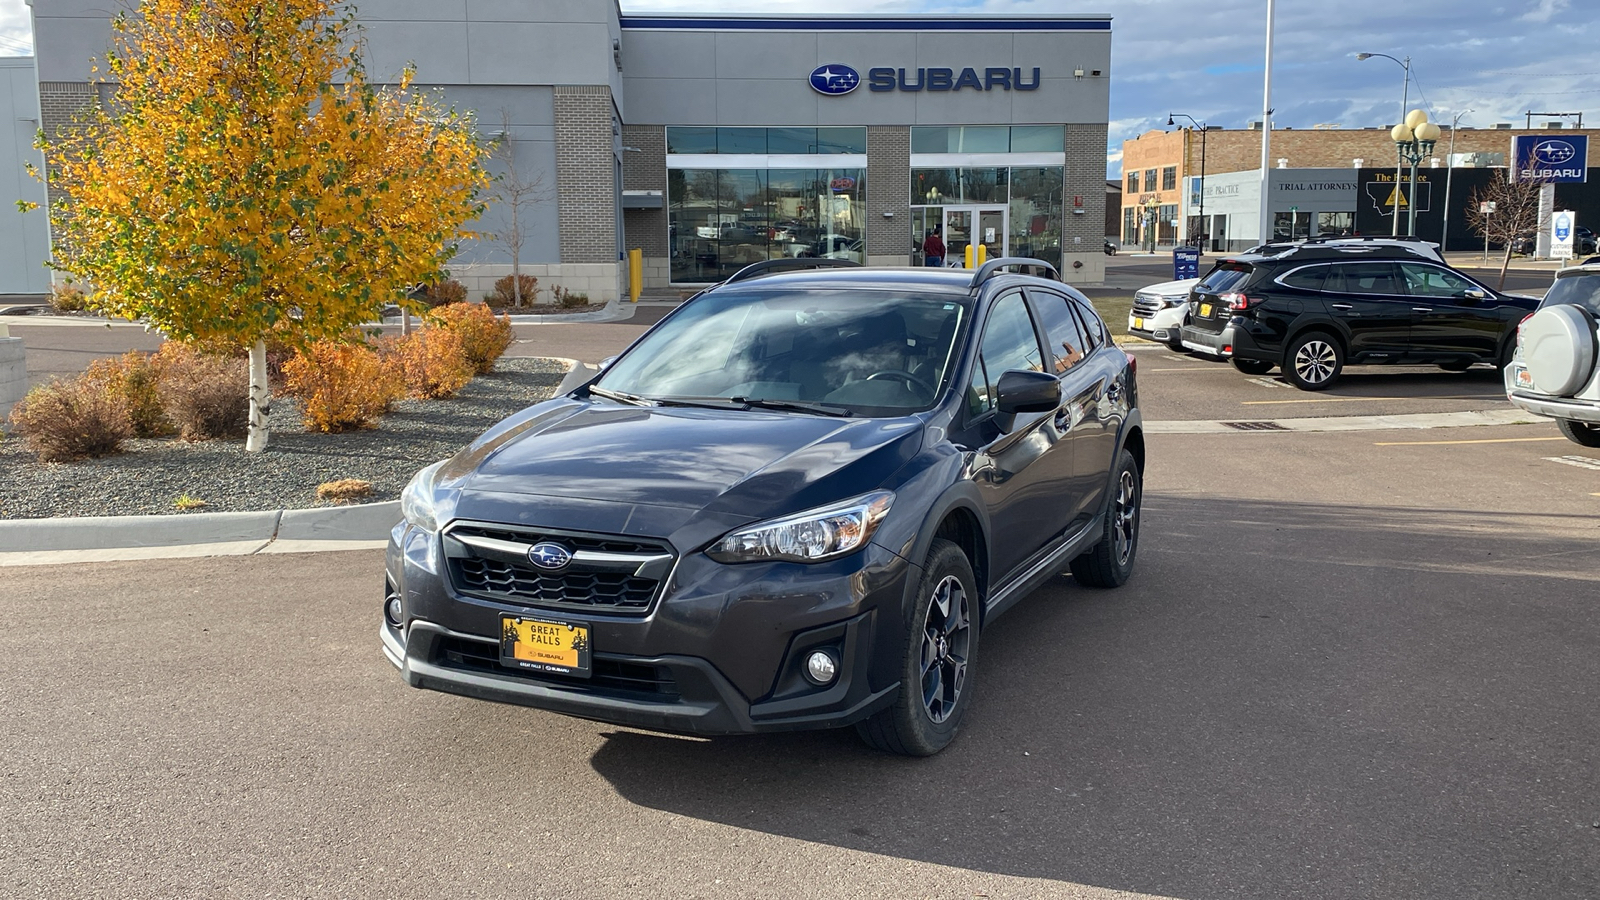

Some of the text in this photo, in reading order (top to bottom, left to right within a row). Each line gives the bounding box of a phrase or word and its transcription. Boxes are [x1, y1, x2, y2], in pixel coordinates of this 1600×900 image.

[869, 67, 1041, 92] SUBARU
[1374, 173, 1391, 181] The
[1521, 169, 1582, 178] SUBARU
[830, 178, 854, 188] OPEN
[1279, 182, 1358, 191] TRIAL ATTORNEYS
[1215, 184, 1240, 195] PRACTICE
[530, 625, 560, 636] GREAT
[531, 634, 561, 646] FALLS
[537, 652, 564, 660] SUBARU
